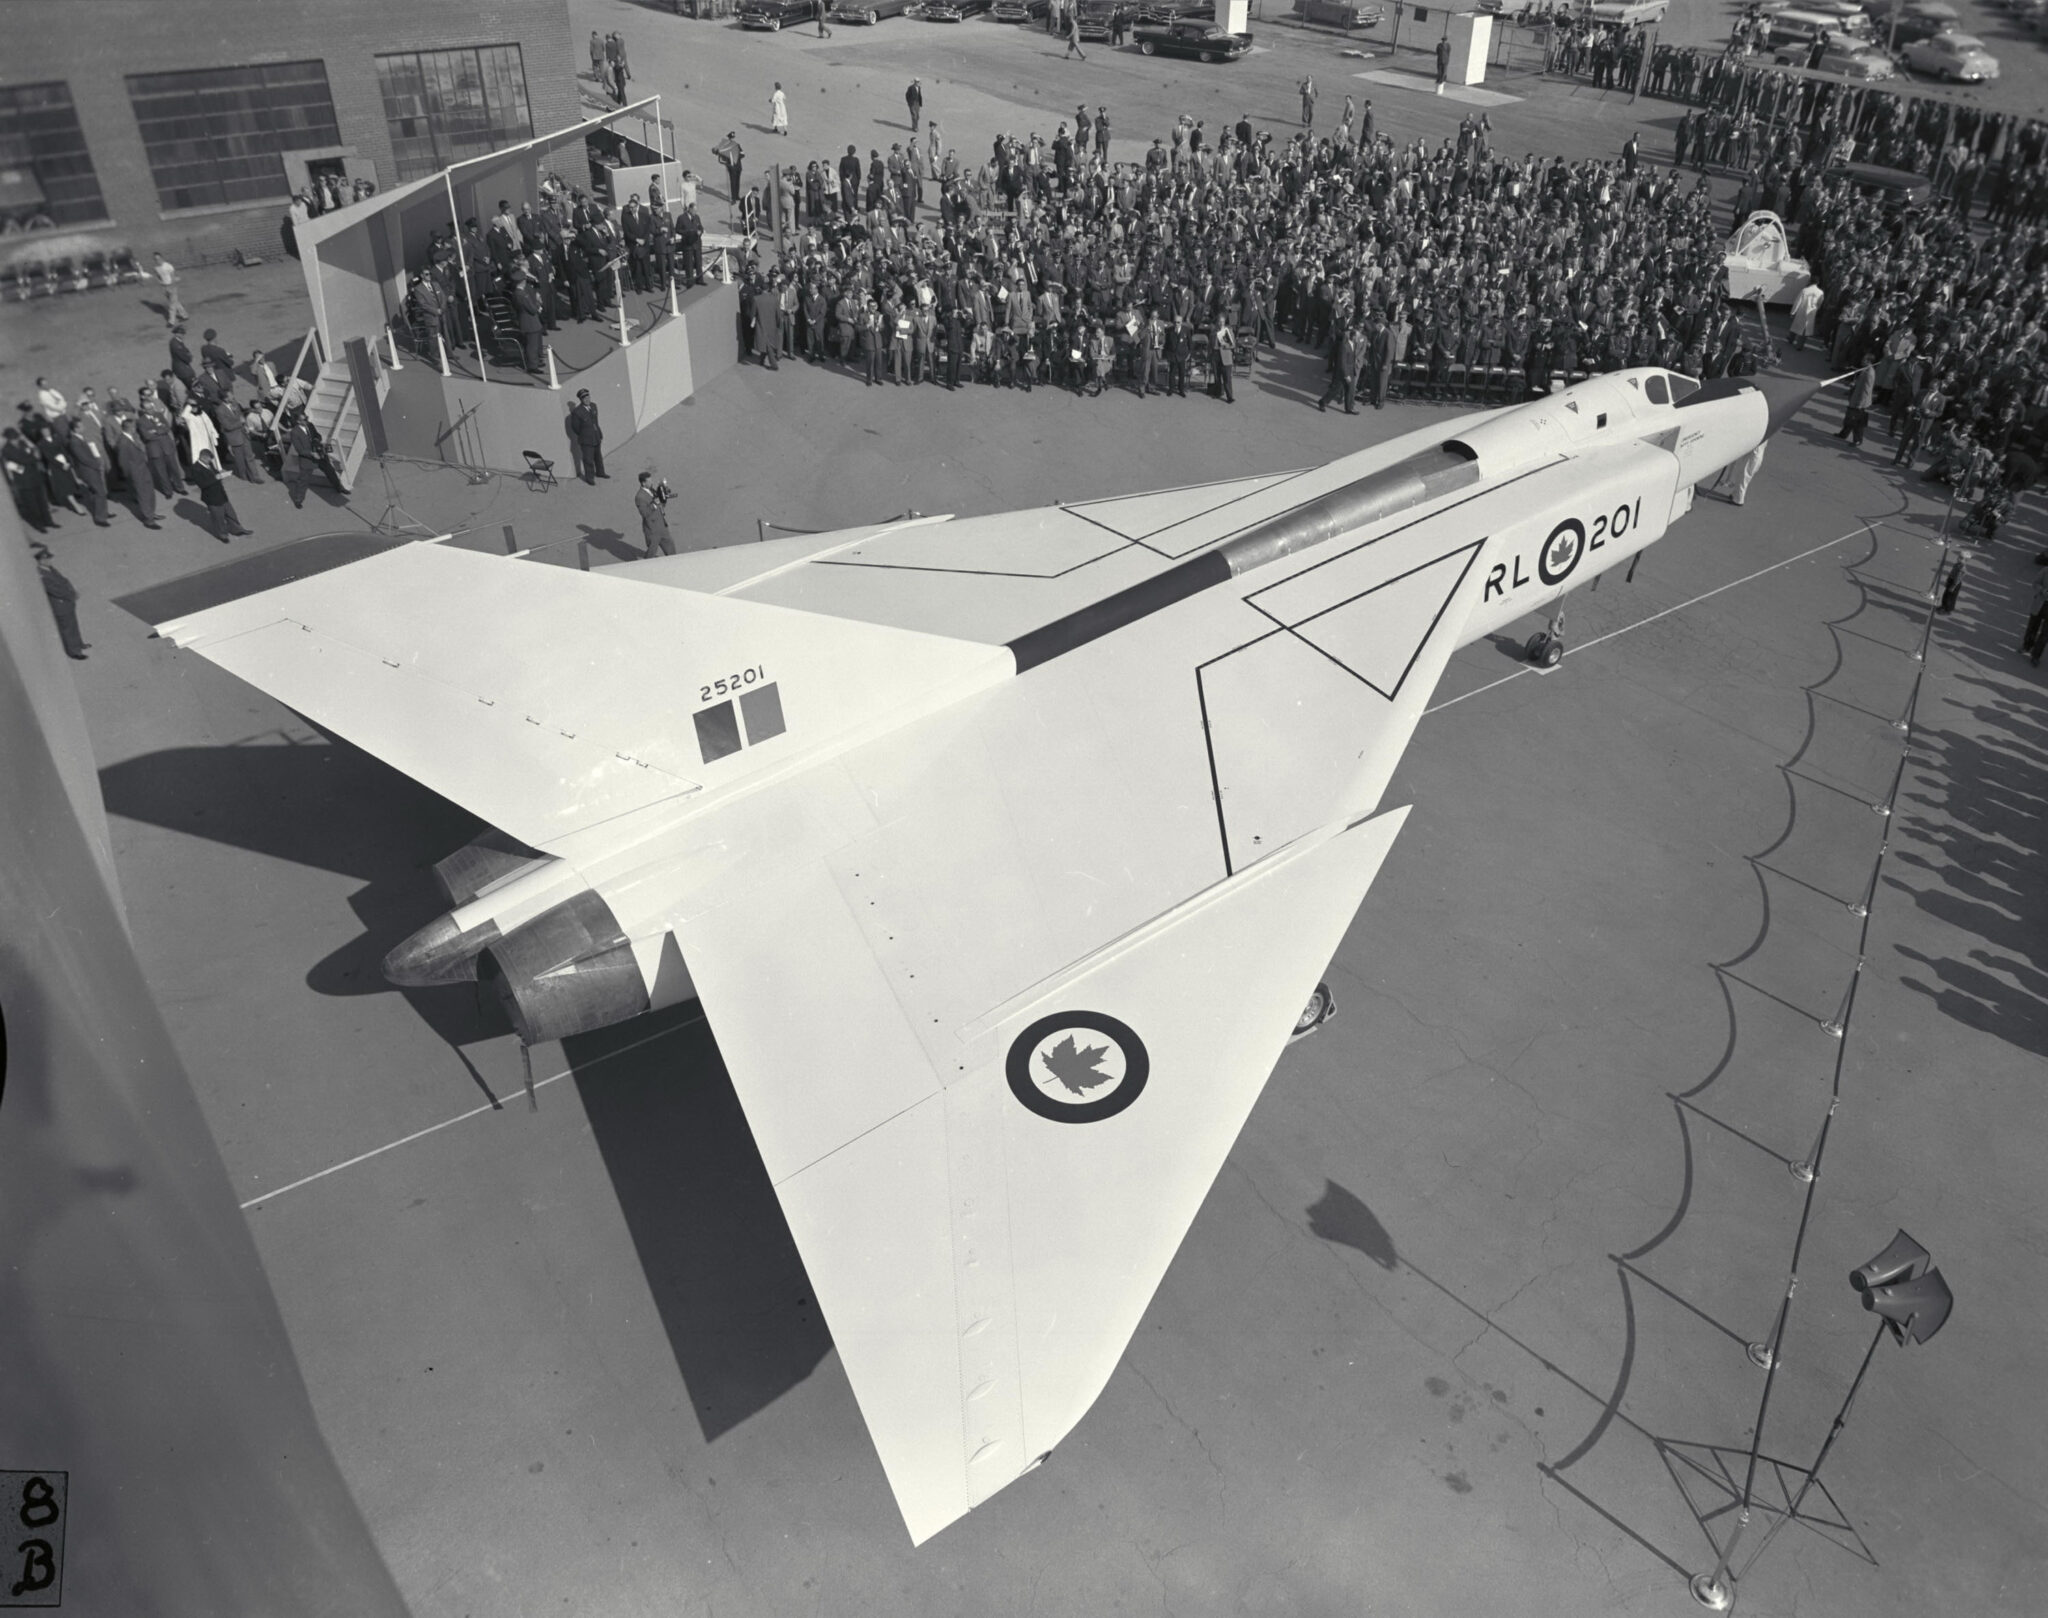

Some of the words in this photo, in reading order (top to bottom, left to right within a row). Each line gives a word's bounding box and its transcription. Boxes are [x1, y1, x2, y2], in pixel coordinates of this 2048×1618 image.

[1483, 554, 1530, 603] RL
[1589, 496, 1641, 552] 201
[699, 664, 764, 702] 25201
